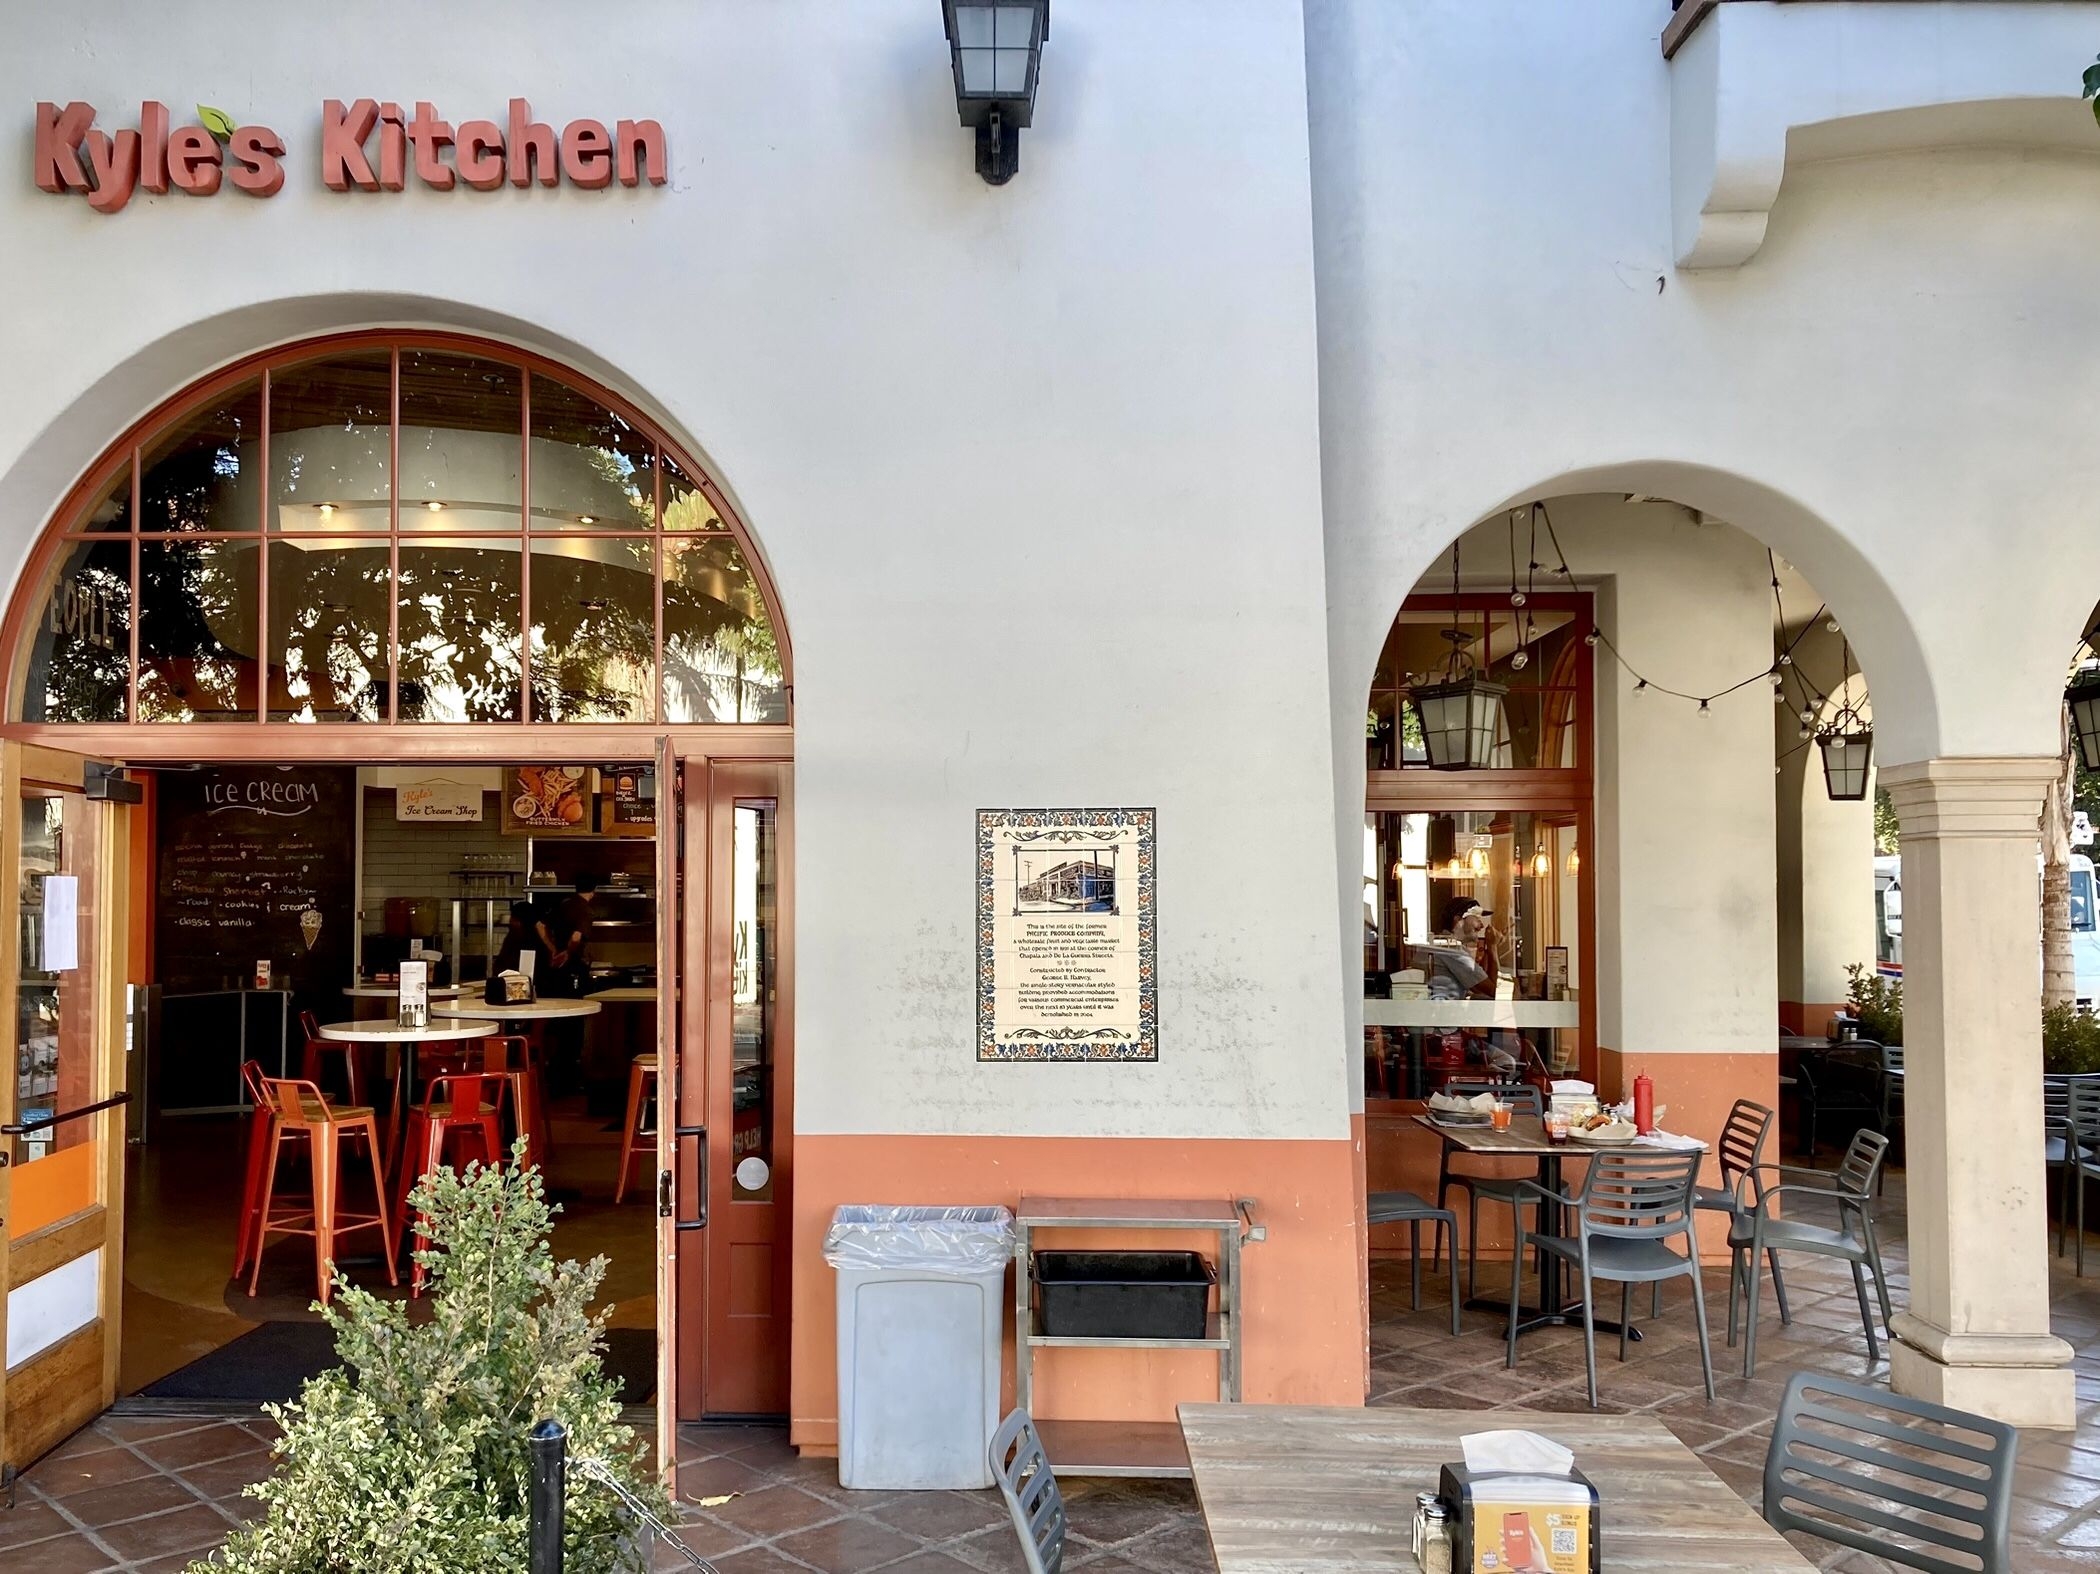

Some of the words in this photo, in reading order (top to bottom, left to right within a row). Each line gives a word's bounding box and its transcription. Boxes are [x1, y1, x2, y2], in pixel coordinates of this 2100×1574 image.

[322, 98, 668, 191] Kitchen
[405, 805, 420, 815] Ice
[424, 805, 452, 815] Cream
[456, 805, 478, 818] Shop
[225, 900, 260, 909] cookies
[280, 903, 311, 911] cream
[179, 917, 211, 927] classic
[218, 918, 252, 927] vanilla
[1546, 1512, 1561, 1526] $5
